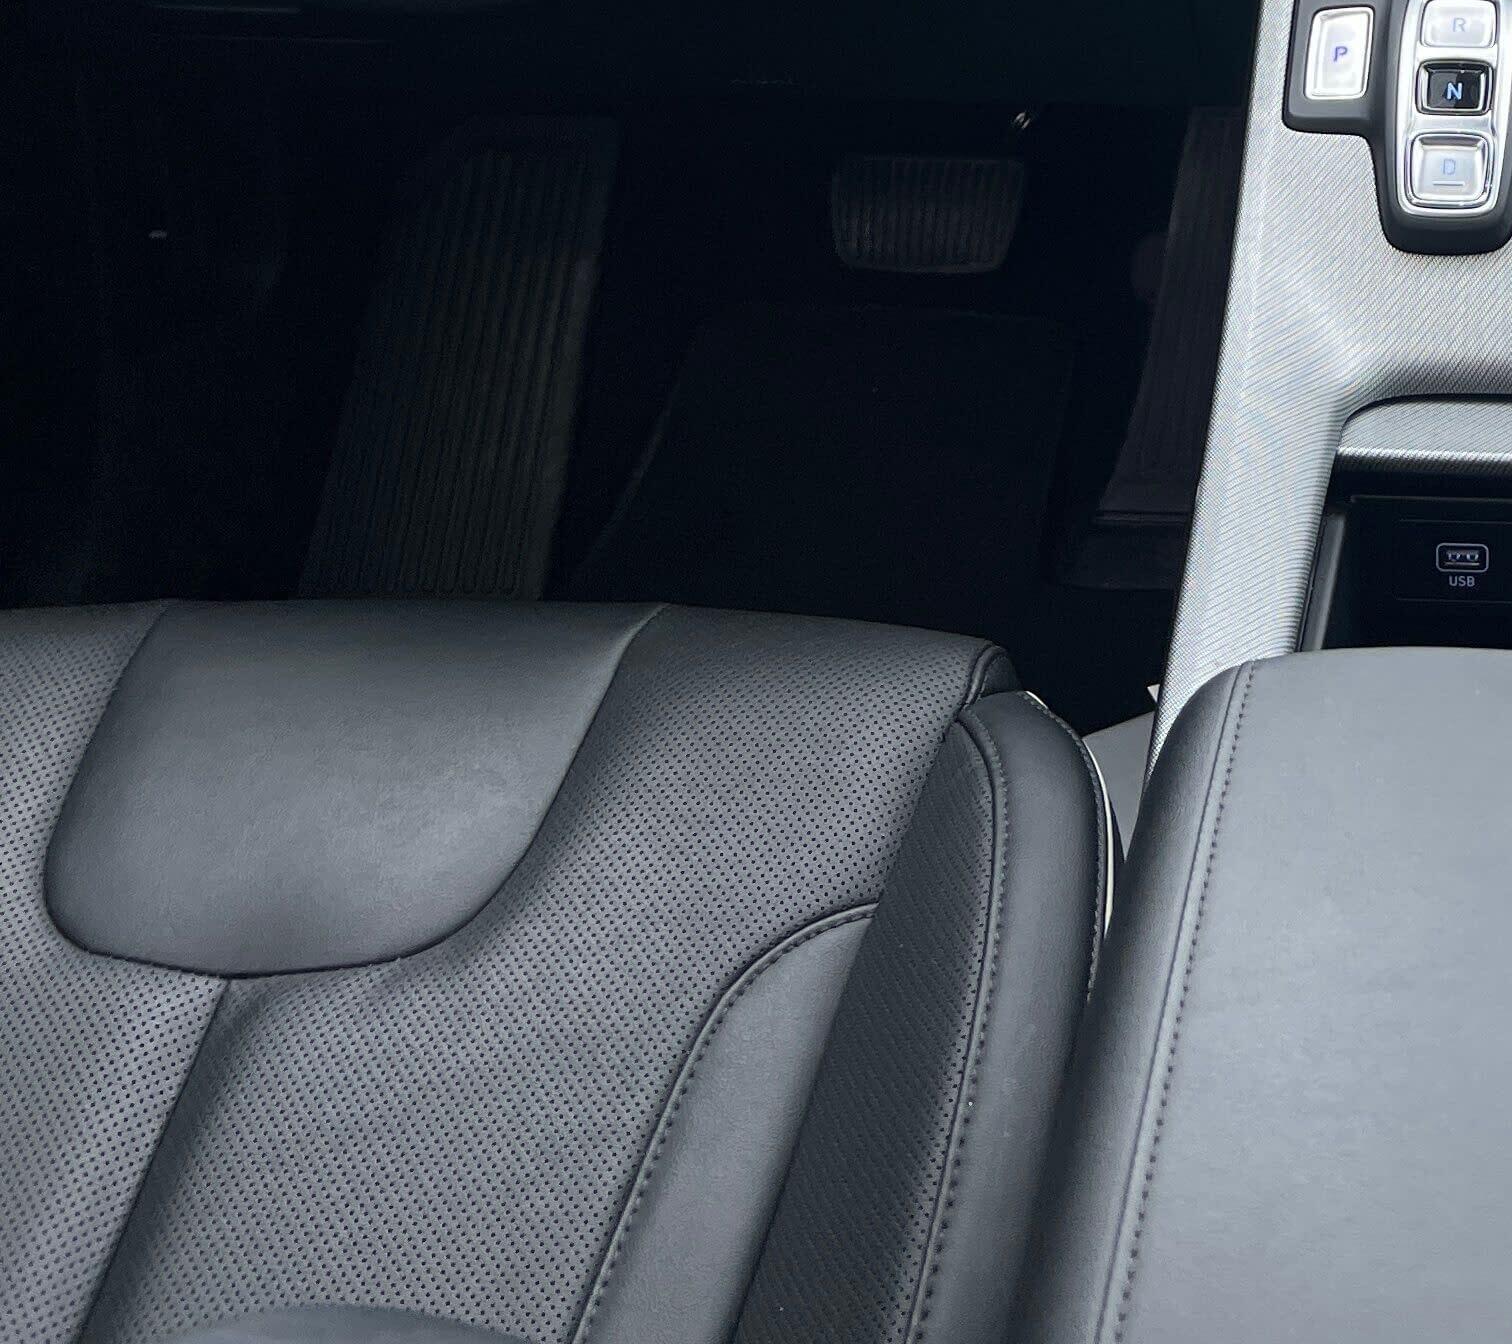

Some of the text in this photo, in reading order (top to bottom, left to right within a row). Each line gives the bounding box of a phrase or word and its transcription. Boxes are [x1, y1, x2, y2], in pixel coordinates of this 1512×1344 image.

[1452, 17, 1467, 33] R
[1333, 46, 1348, 62] P
[1446, 82, 1463, 100] N
[1442, 158, 1457, 175] D
[1448, 575, 1476, 587] USB
